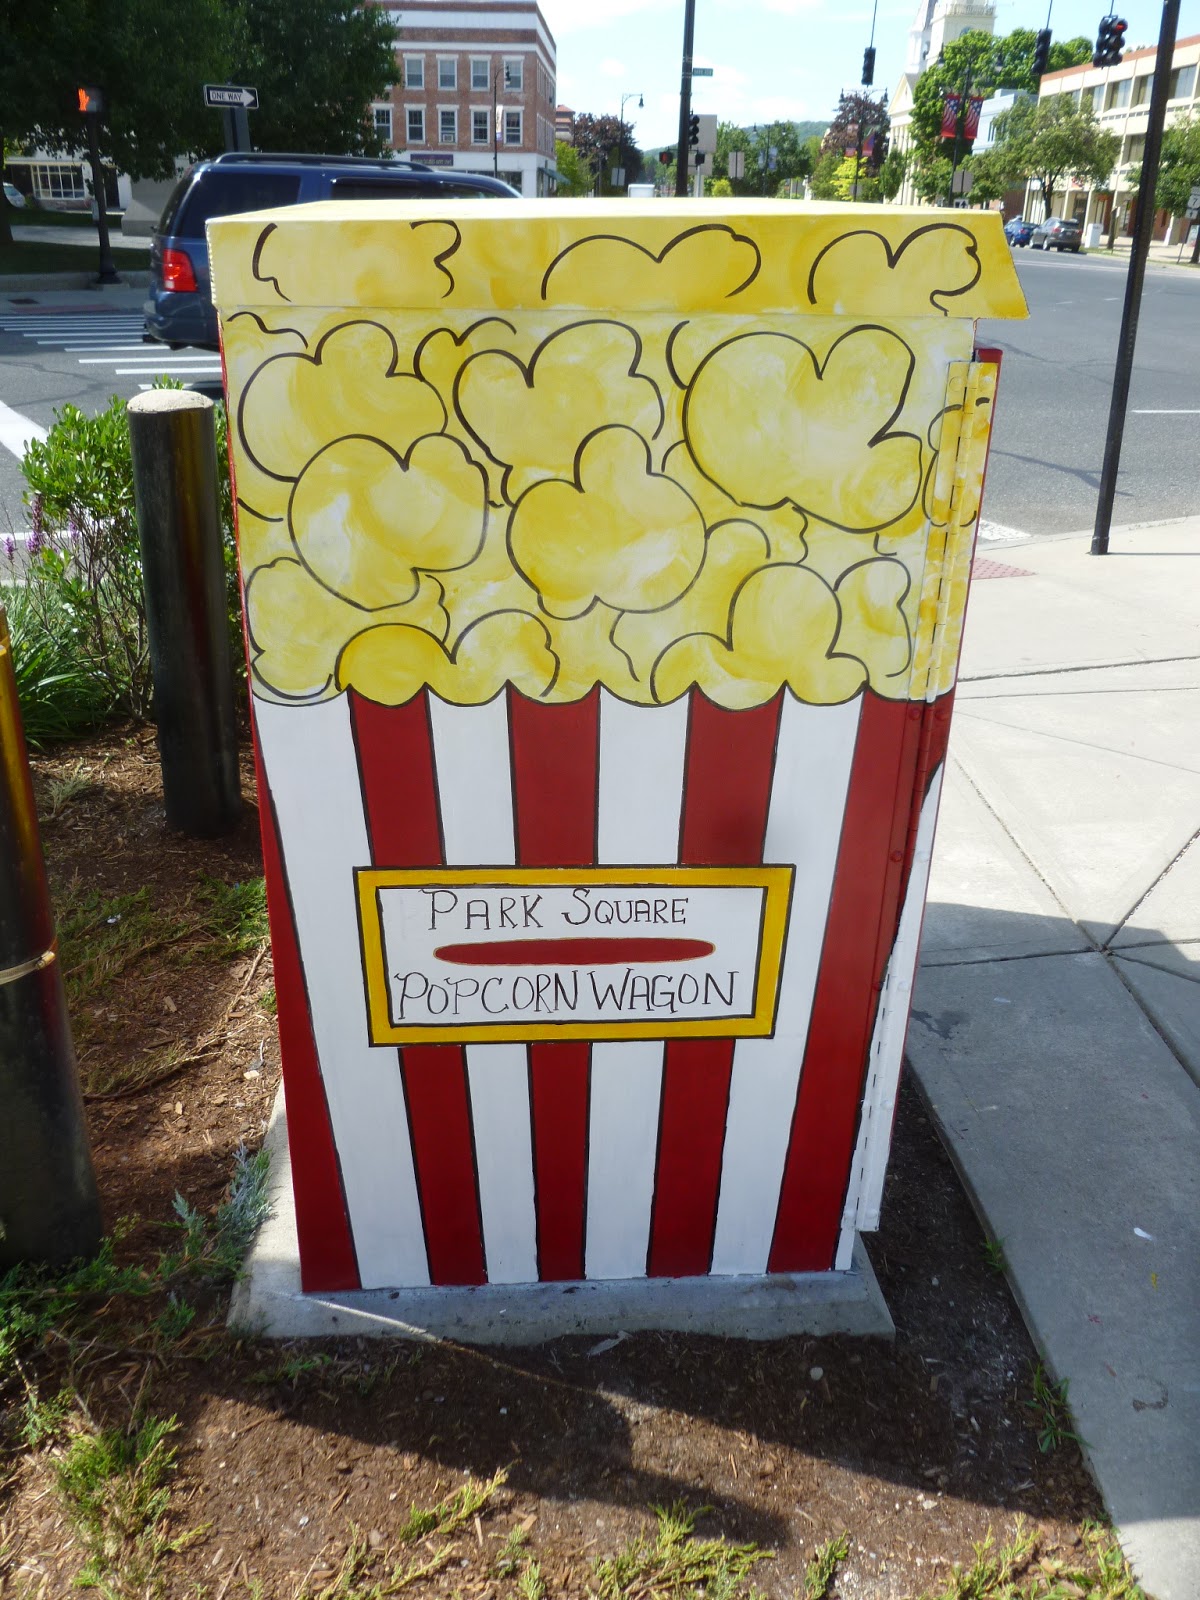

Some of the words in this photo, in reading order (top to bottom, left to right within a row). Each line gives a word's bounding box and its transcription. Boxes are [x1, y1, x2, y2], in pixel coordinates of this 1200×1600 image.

[211, 91, 226, 101] ONE
[227, 92, 242, 102] WAY
[421, 888, 544, 931] PARK
[561, 887, 690, 926] SQUARE
[393, 969, 579, 1020] POPCORN
[587, 967, 740, 1014] WAGON
